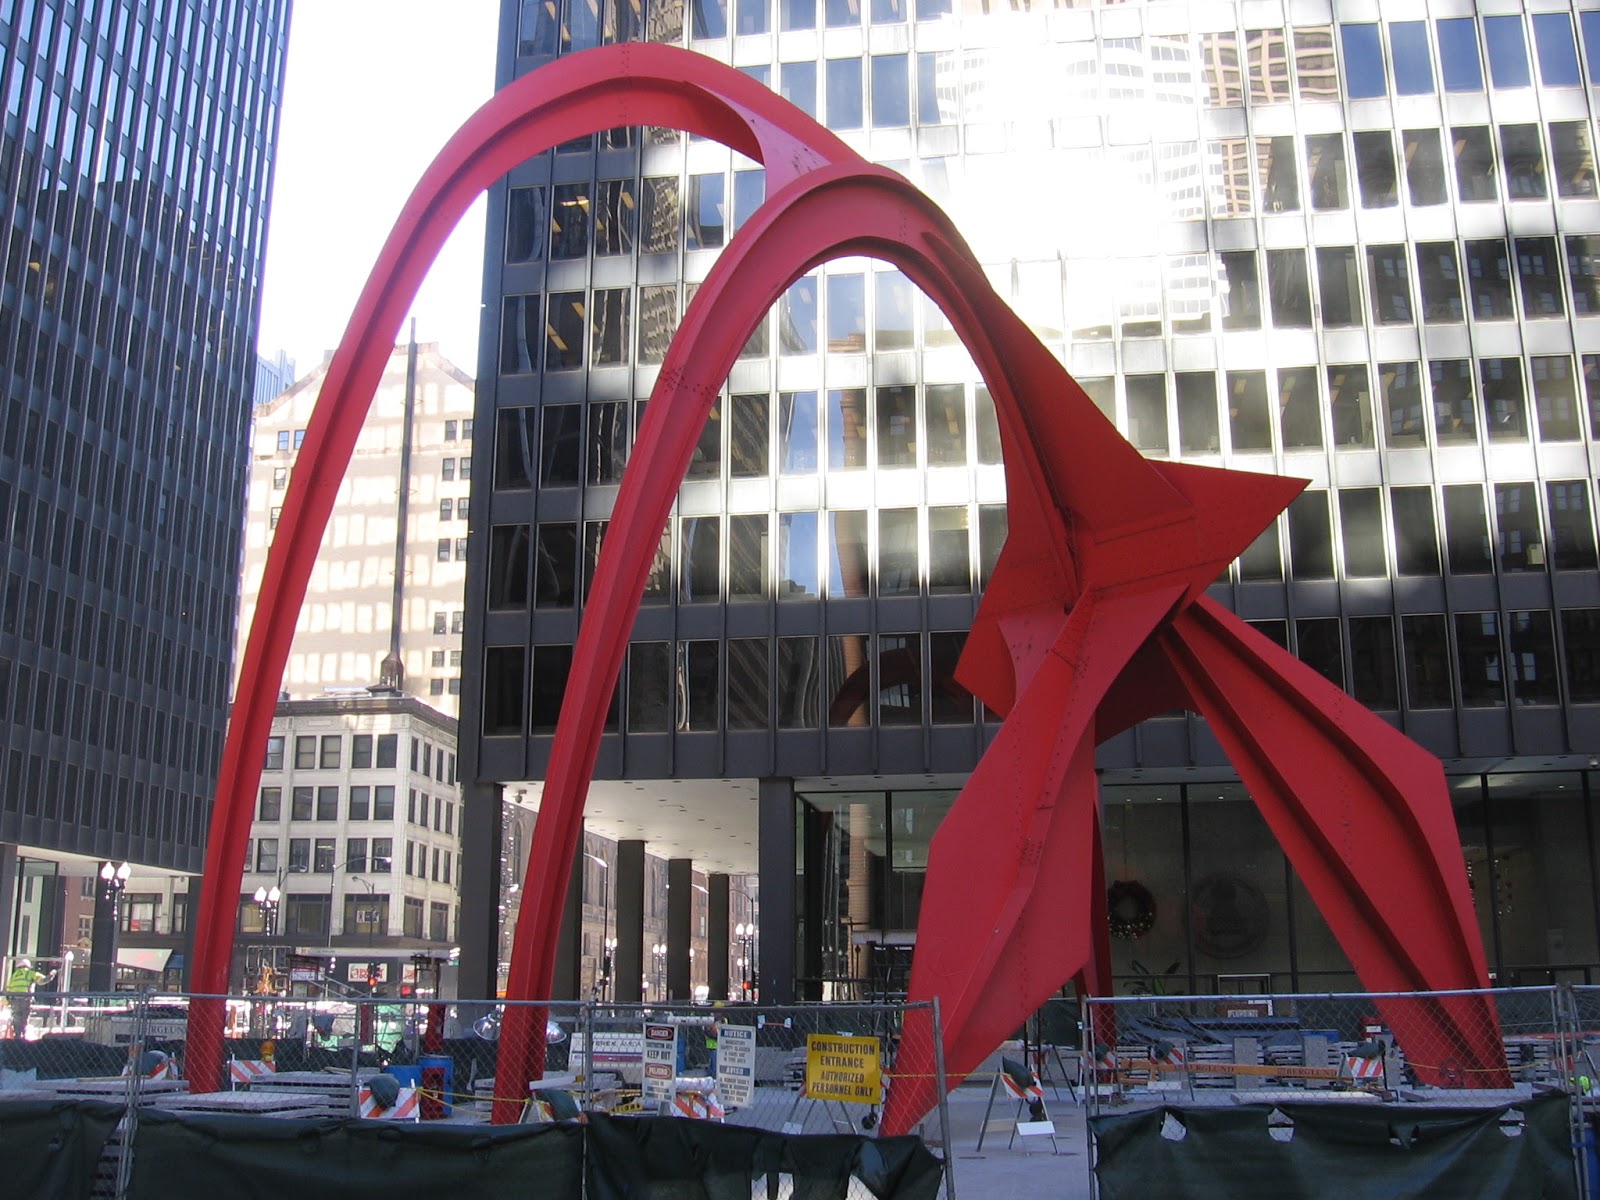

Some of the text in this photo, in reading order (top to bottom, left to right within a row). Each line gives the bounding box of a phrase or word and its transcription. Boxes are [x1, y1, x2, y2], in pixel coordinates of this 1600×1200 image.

[650, 1029, 669, 1037] DANGER
[724, 1029, 748, 1038] NOTICE
[811, 1041, 875, 1055] CONSTRUCTION
[647, 1050, 671, 1060] KEEP OUT
[820, 1056, 865, 1069] ENTRANCE
[725, 1067, 744, 1075] AVISO
[821, 1070, 865, 1083] AUTHORIZED
[812, 1082, 874, 1097] PERSONNEL ONLY
